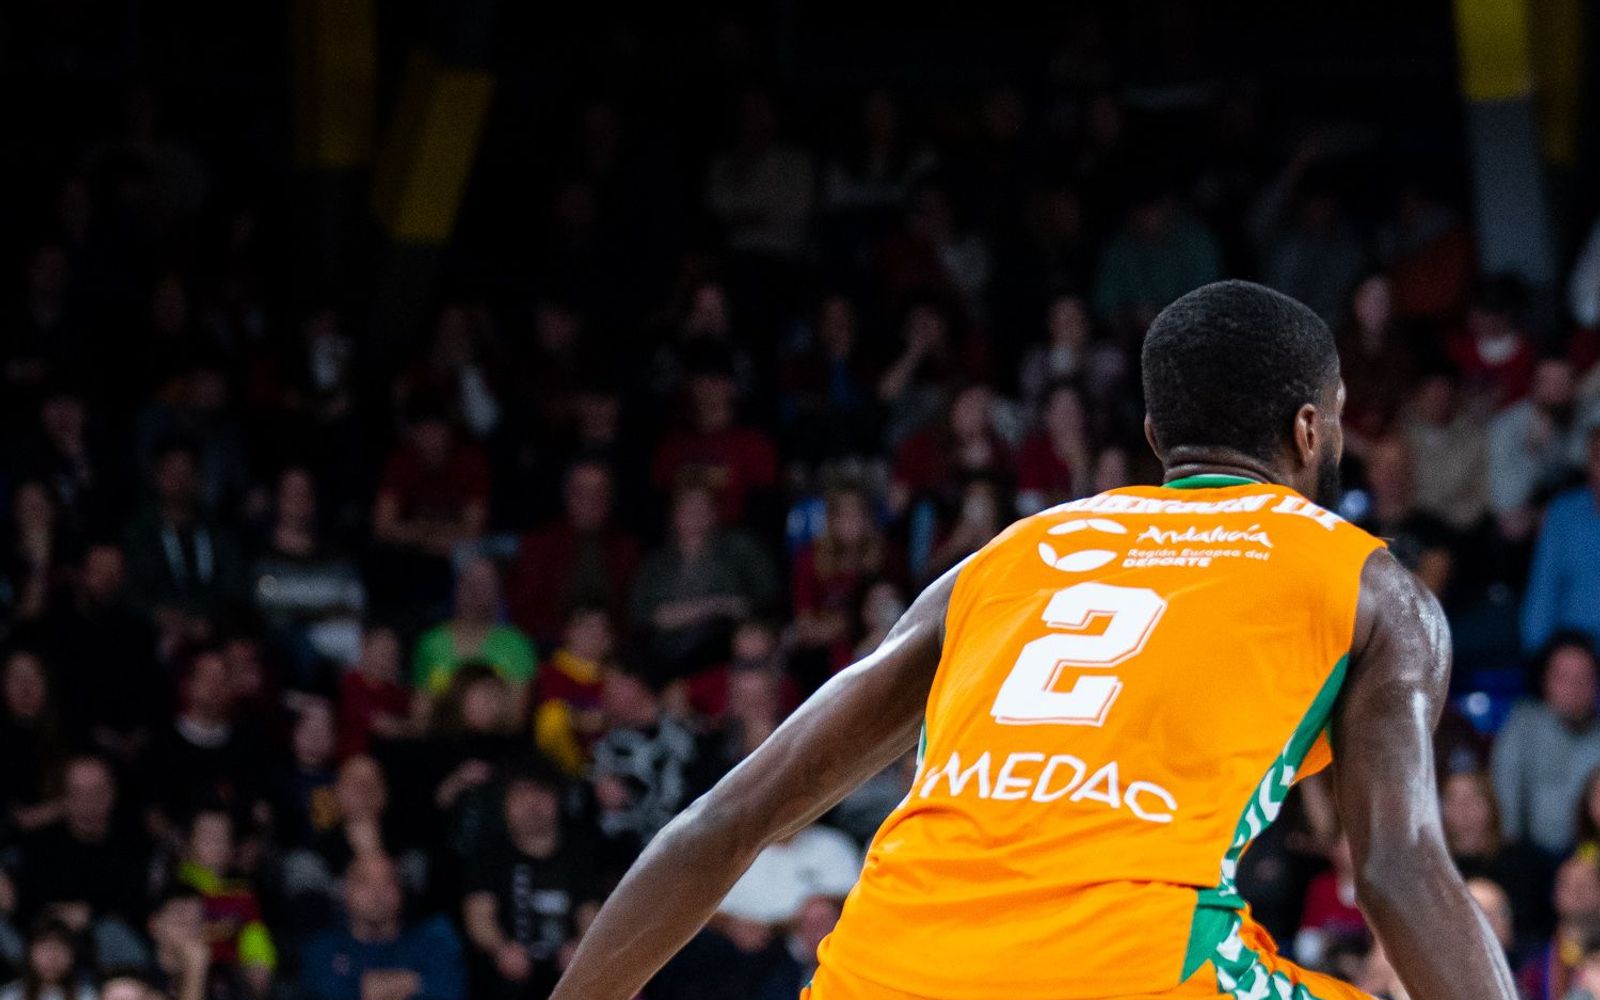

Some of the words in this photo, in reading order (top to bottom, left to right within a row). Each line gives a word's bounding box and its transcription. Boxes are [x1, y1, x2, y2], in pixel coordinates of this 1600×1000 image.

[1121, 556, 1213, 568] DEPORTE
[989, 580, 1168, 727] 2
[918, 751, 1178, 823] MEDAC
